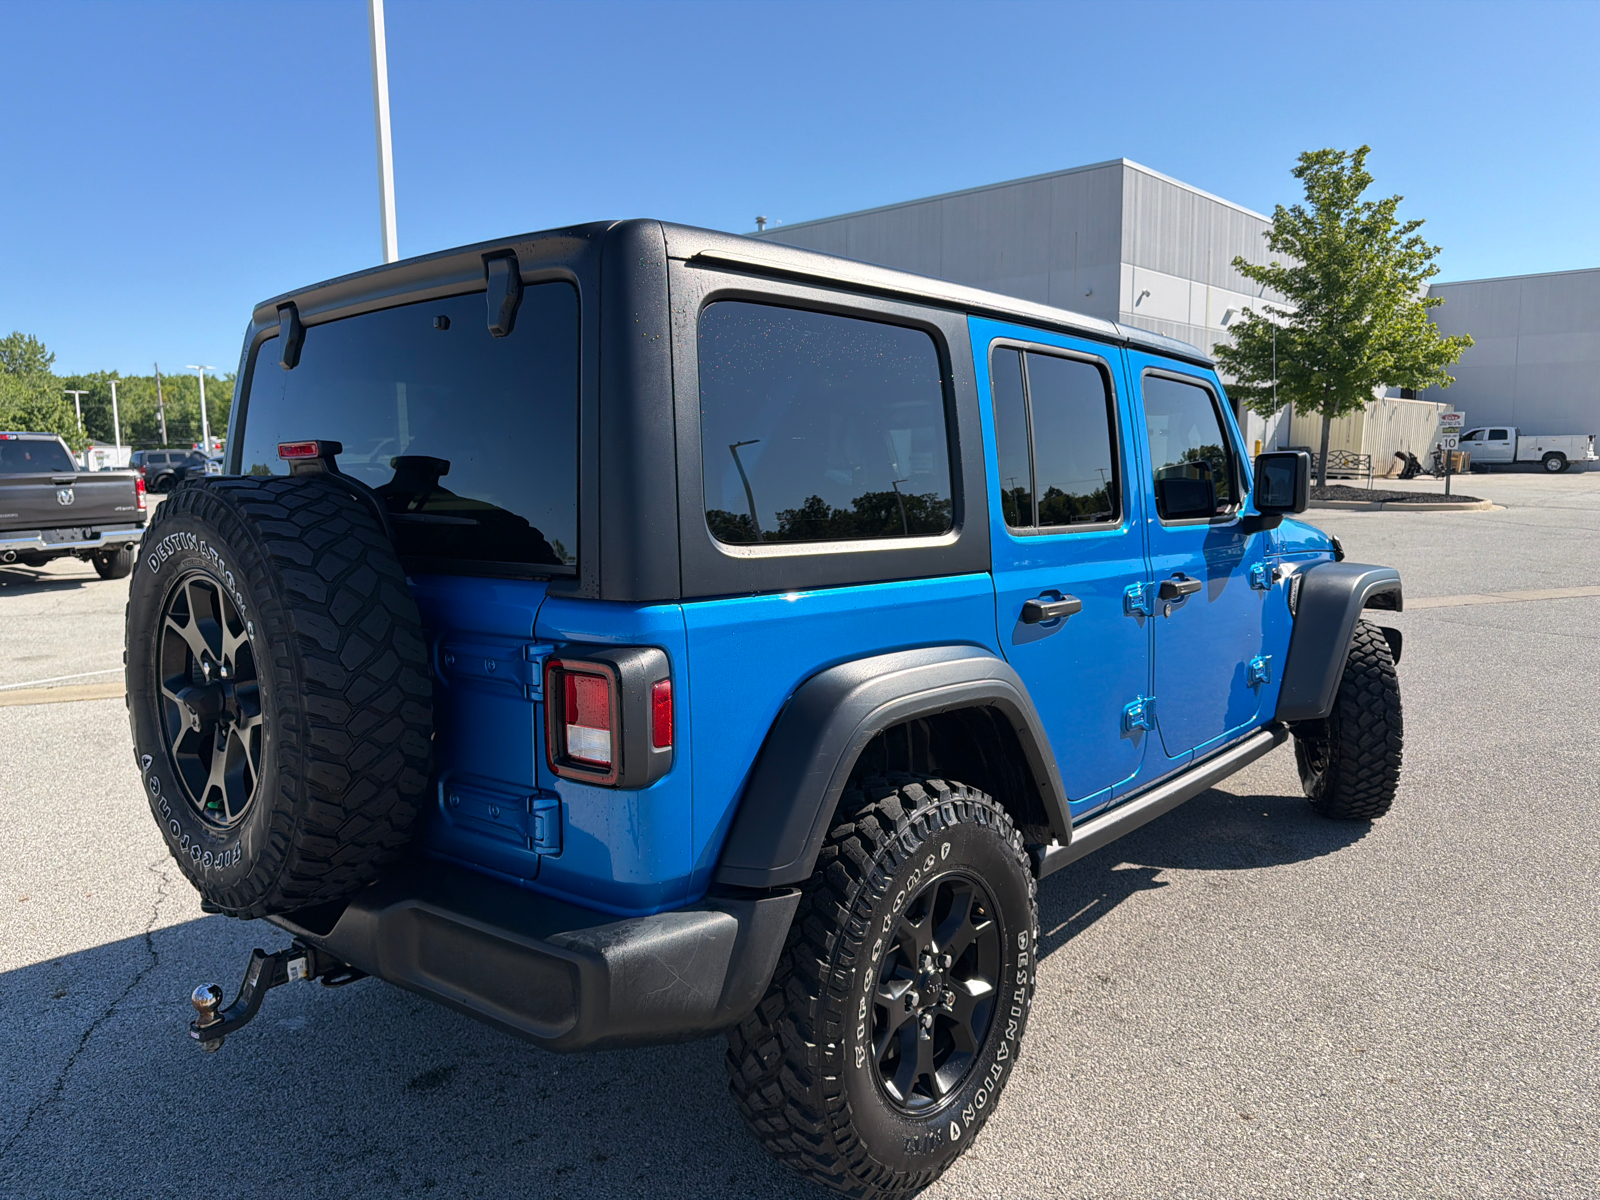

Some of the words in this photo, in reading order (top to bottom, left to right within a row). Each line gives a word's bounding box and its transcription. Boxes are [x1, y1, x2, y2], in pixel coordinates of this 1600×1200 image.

[1444, 438, 1456, 448] 10
[147, 532, 247, 617] DESTINATION
[962, 930, 1029, 1128] DESTINATION
